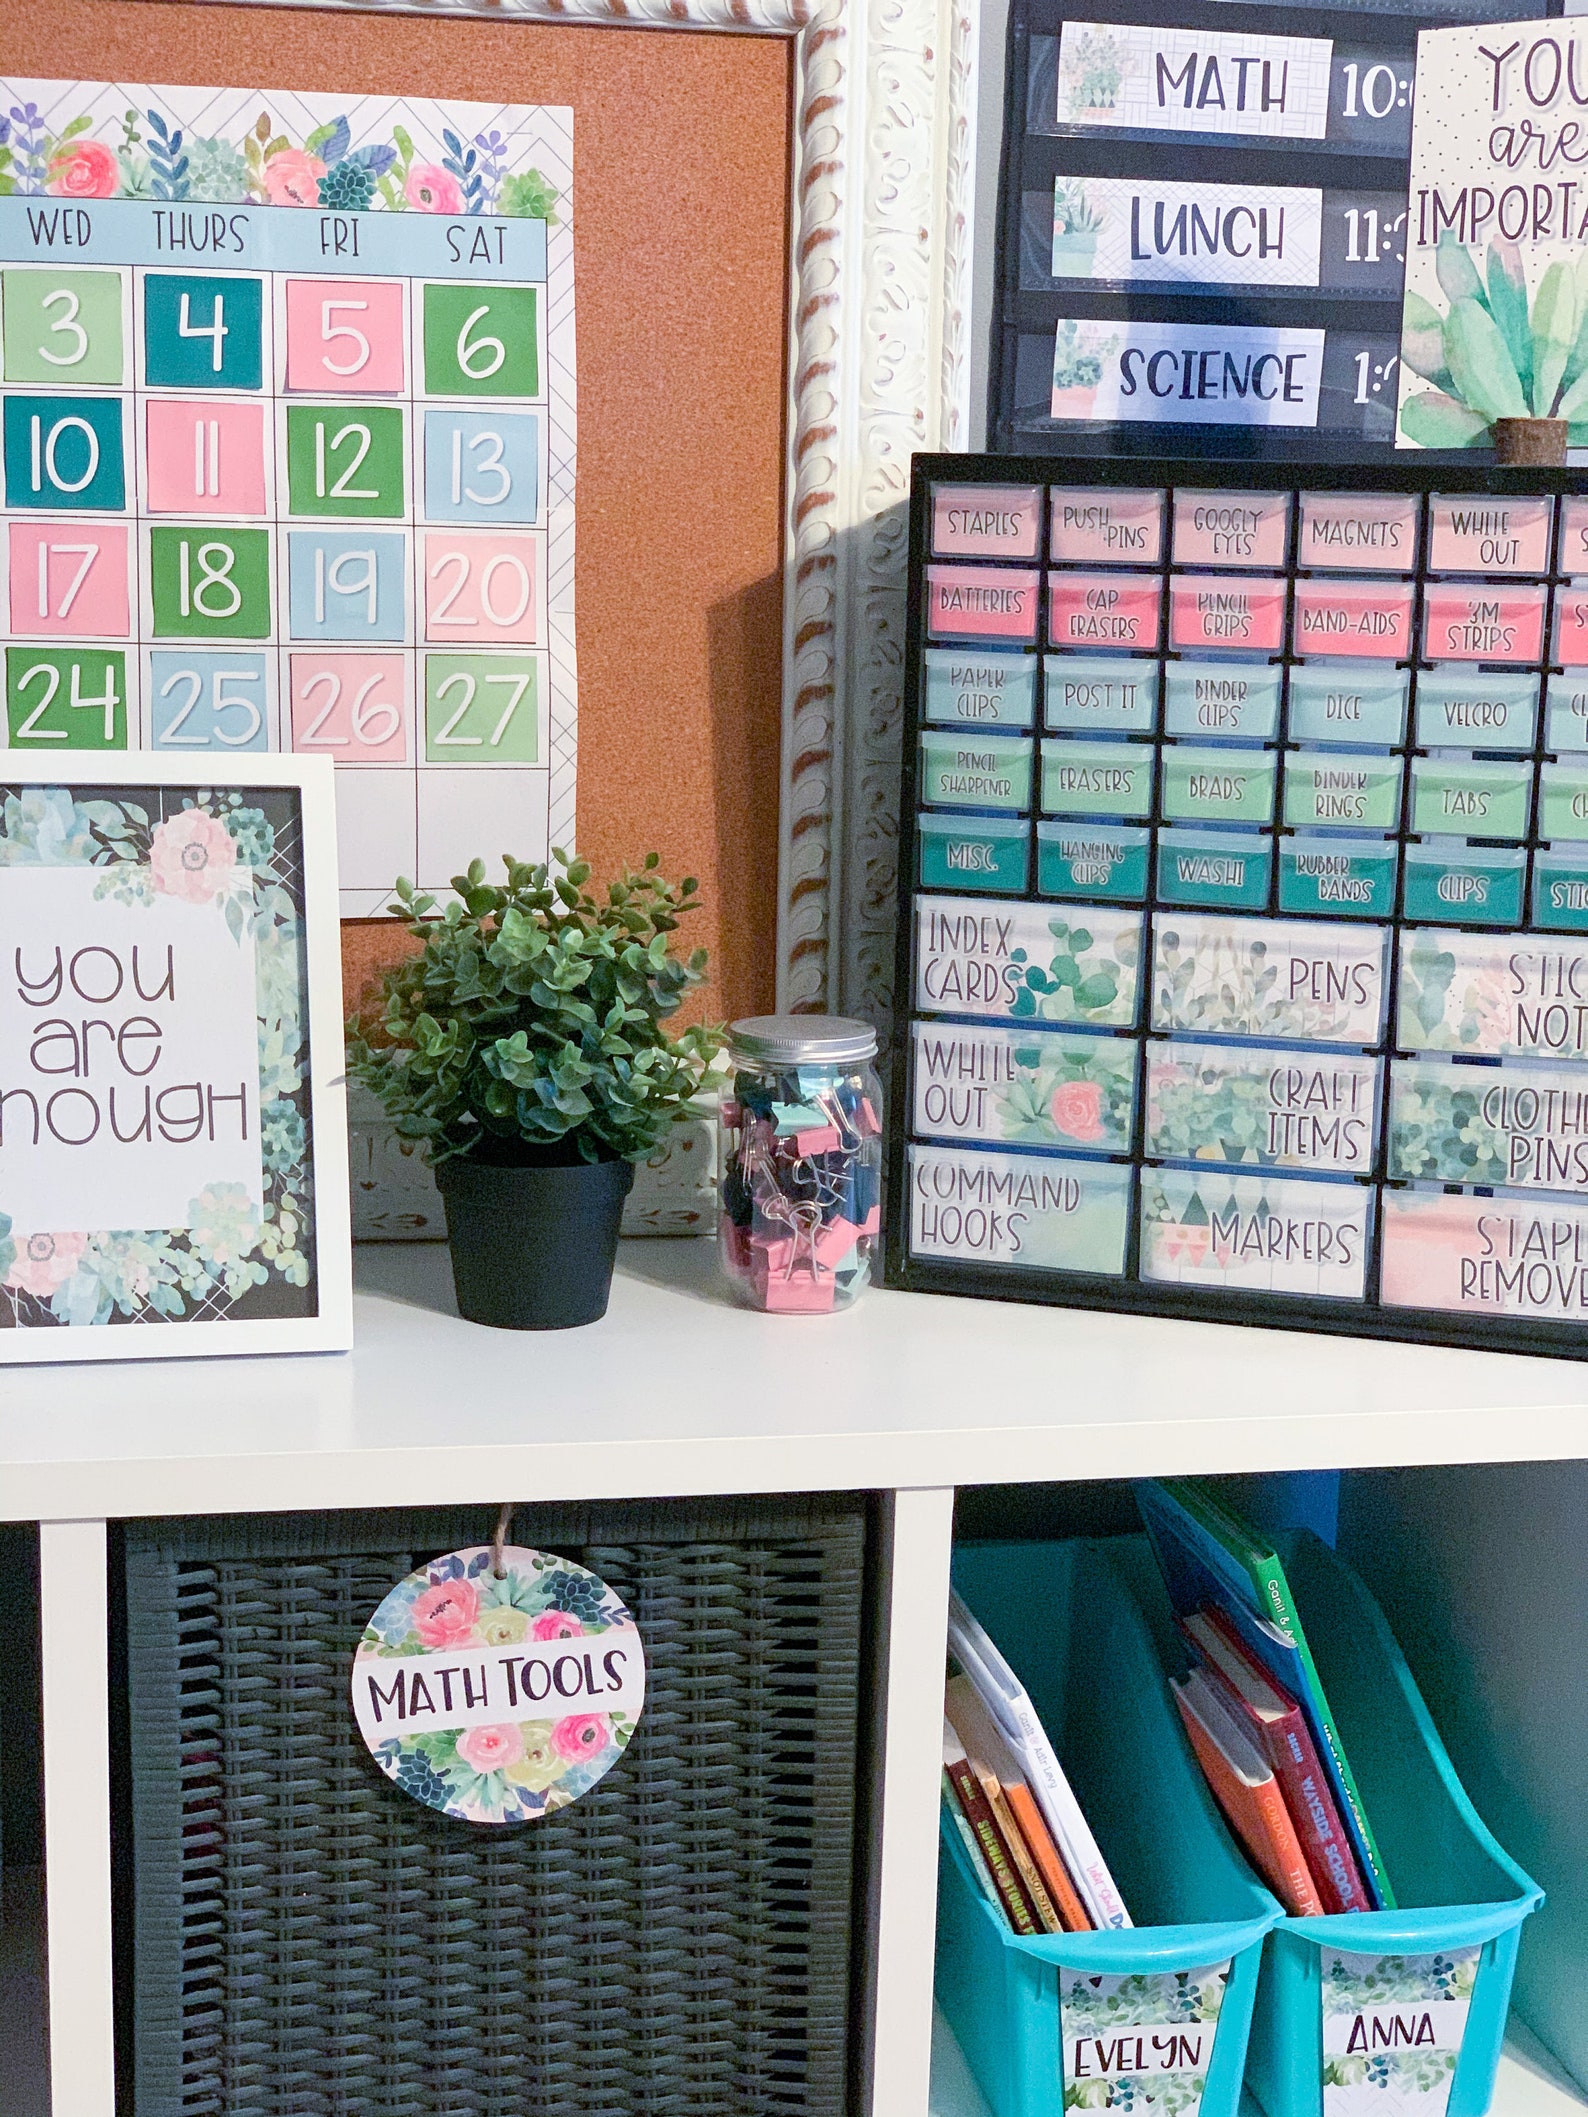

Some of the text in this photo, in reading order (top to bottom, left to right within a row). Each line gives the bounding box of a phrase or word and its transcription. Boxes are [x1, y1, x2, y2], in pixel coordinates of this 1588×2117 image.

[1156, 52, 1288, 113] MATH
[1343, 63, 1414, 118] 10:
[1488, 119, 1588, 169] are
[27, 208, 509, 264] WED THURS FRI SAT
[1131, 196, 1284, 260] LUNCH
[38, 289, 506, 380] 3 4 5 6
[1120, 349, 1306, 402] SCIENCE
[31, 415, 511, 505] 10 11 12 13
[948, 509, 1023, 538] STAPLES
[1064, 506, 1110, 530] PUSH
[1194, 506, 1264, 533] GOOGLY
[1107, 525, 1149, 549] PINS
[1213, 532, 1253, 556] EYES
[1312, 519, 1403, 547] MAGNETS
[1480, 539, 1520, 565] OUT
[39, 541, 531, 626] 17 18 19 20
[940, 586, 1026, 614] BATTERIES
[1086, 588, 1119, 611] CAP
[1198, 592, 1249, 614] PENCIL
[1468, 601, 1500, 625] 3M
[1070, 615, 1140, 640] ERASERS
[1203, 614, 1253, 638] GRIPS
[1303, 608, 1401, 636] BAND-AIDS
[1447, 625, 1517, 652] STRIPS
[950, 666, 1005, 689] PAPER
[1195, 679, 1247, 702] BINDER
[17, 664, 530, 746] 24 25 26 27
[957, 695, 1002, 719] CLIPS
[1064, 684, 1138, 709] POST IT
[1326, 696, 1362, 721] DICE
[1198, 703, 1242, 728] CLIPS
[1444, 702, 1508, 727] VELCRO
[957, 751, 997, 773] PENCIL
[940, 774, 1011, 797] SHARPENER
[1060, 767, 1135, 793] ERASERS
[1190, 775, 1247, 801] BRADS
[1314, 769, 1368, 791] BINDER
[1315, 794, 1368, 819] RINGS
[1442, 789, 1492, 816] TABS
[947, 842, 998, 871] MISC.
[1060, 840, 1124, 863] HANGING
[1297, 854, 1350, 876] RUBBER
[1070, 862, 1112, 885] CLIPS
[1177, 856, 1245, 887] WASHI
[1319, 878, 1375, 902] BANDS
[1437, 876, 1490, 902] CLIPS
[928, 911, 1013, 957] INDEX
[15, 944, 176, 1007] you
[924, 956, 1024, 1006] CARDS
[1289, 958, 1375, 1006] PENS
[30, 1016, 163, 1078] are
[924, 1038, 1017, 1082] WHITE
[1269, 1067, 1361, 1112] CRAFT
[924, 1084, 988, 1129] OUT
[1268, 1111, 1366, 1161] ITEMS
[1509, 1135, 1588, 1184] PINS
[917, 1163, 1080, 1213] COMMAND
[921, 1206, 1028, 1253] HOOKS
[1210, 1213, 1359, 1266] MARKERS
[367, 1649, 628, 1723] MATH TOOLS
[1263, 1795, 1291, 1851] GORDON
[1301, 1774, 1334, 1843] WAYSIDE
[1324, 1843, 1355, 1906] SCHOOL
[976, 1819, 1011, 1878] SIDEWAYS
[1002, 1878, 1031, 1926] STORIES
[1289, 1866, 1308, 1901] THE
[1346, 2012, 1437, 2054] ANNA
[1074, 2035, 1202, 2078] EVELYN
